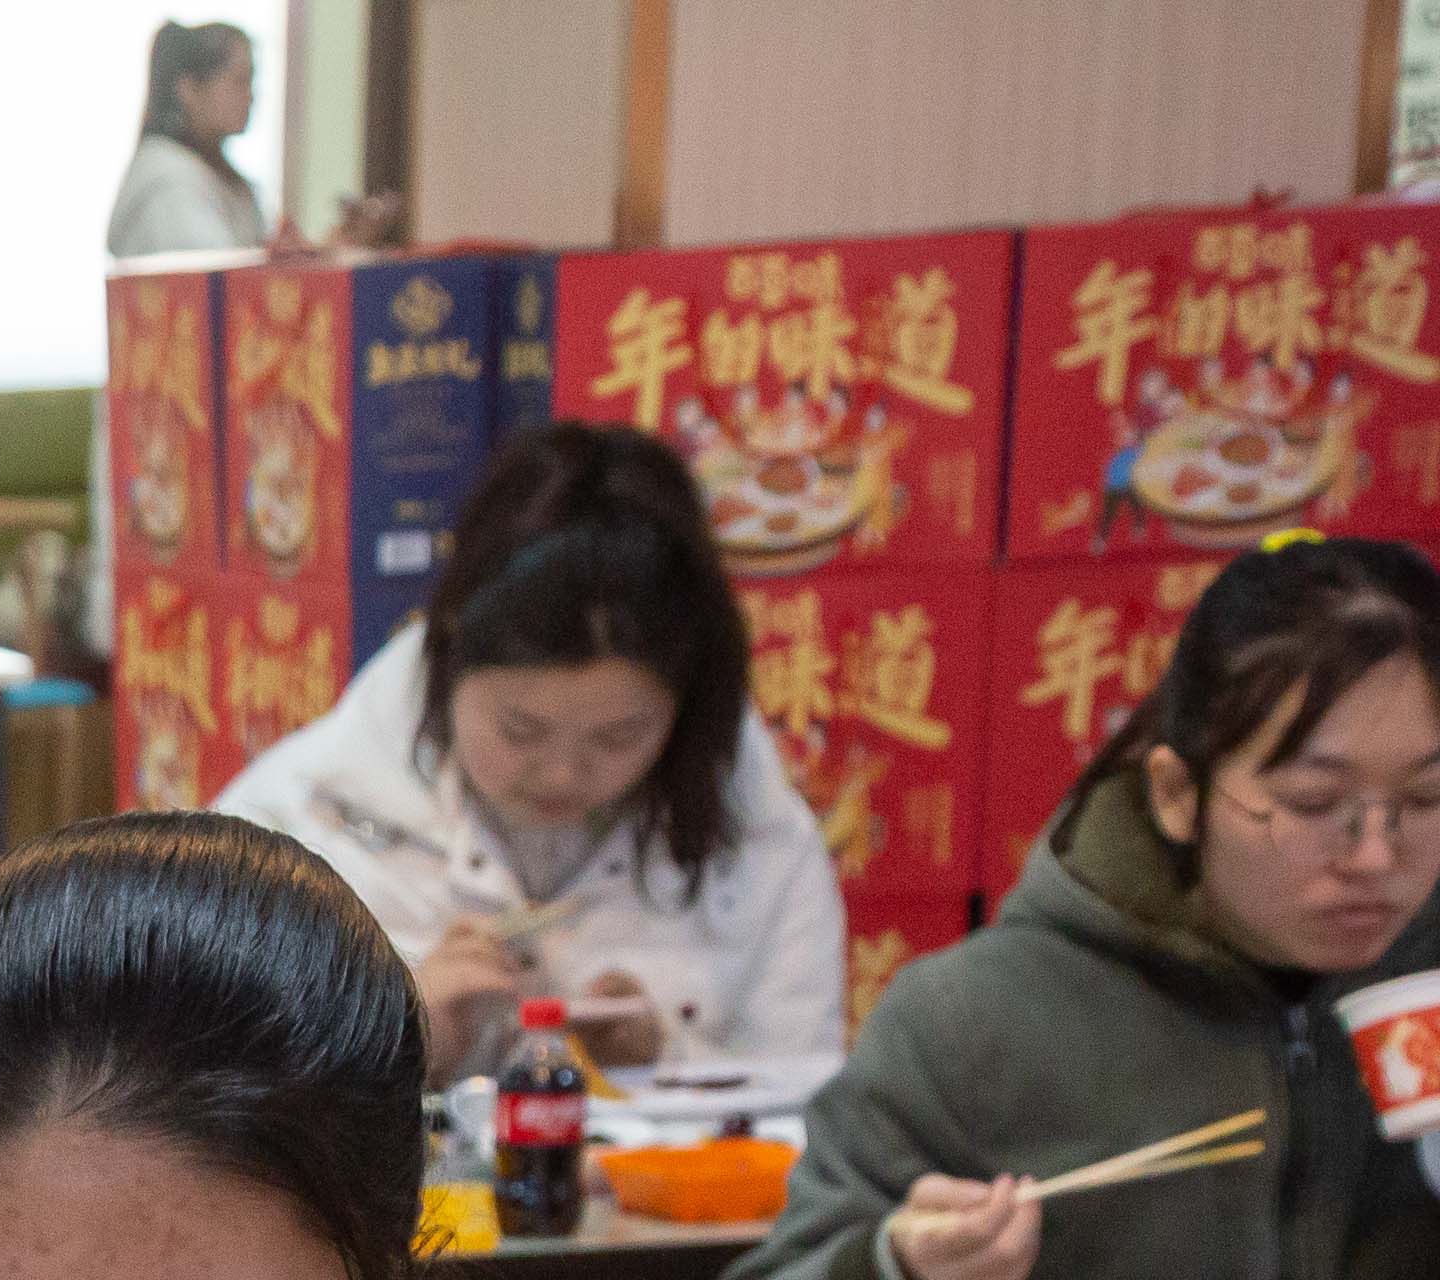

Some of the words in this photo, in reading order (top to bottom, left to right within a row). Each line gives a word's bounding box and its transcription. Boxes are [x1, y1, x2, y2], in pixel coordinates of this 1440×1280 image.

[588, 267, 974, 432] 年的味道
[1052, 236, 1440, 403] 年的味道
